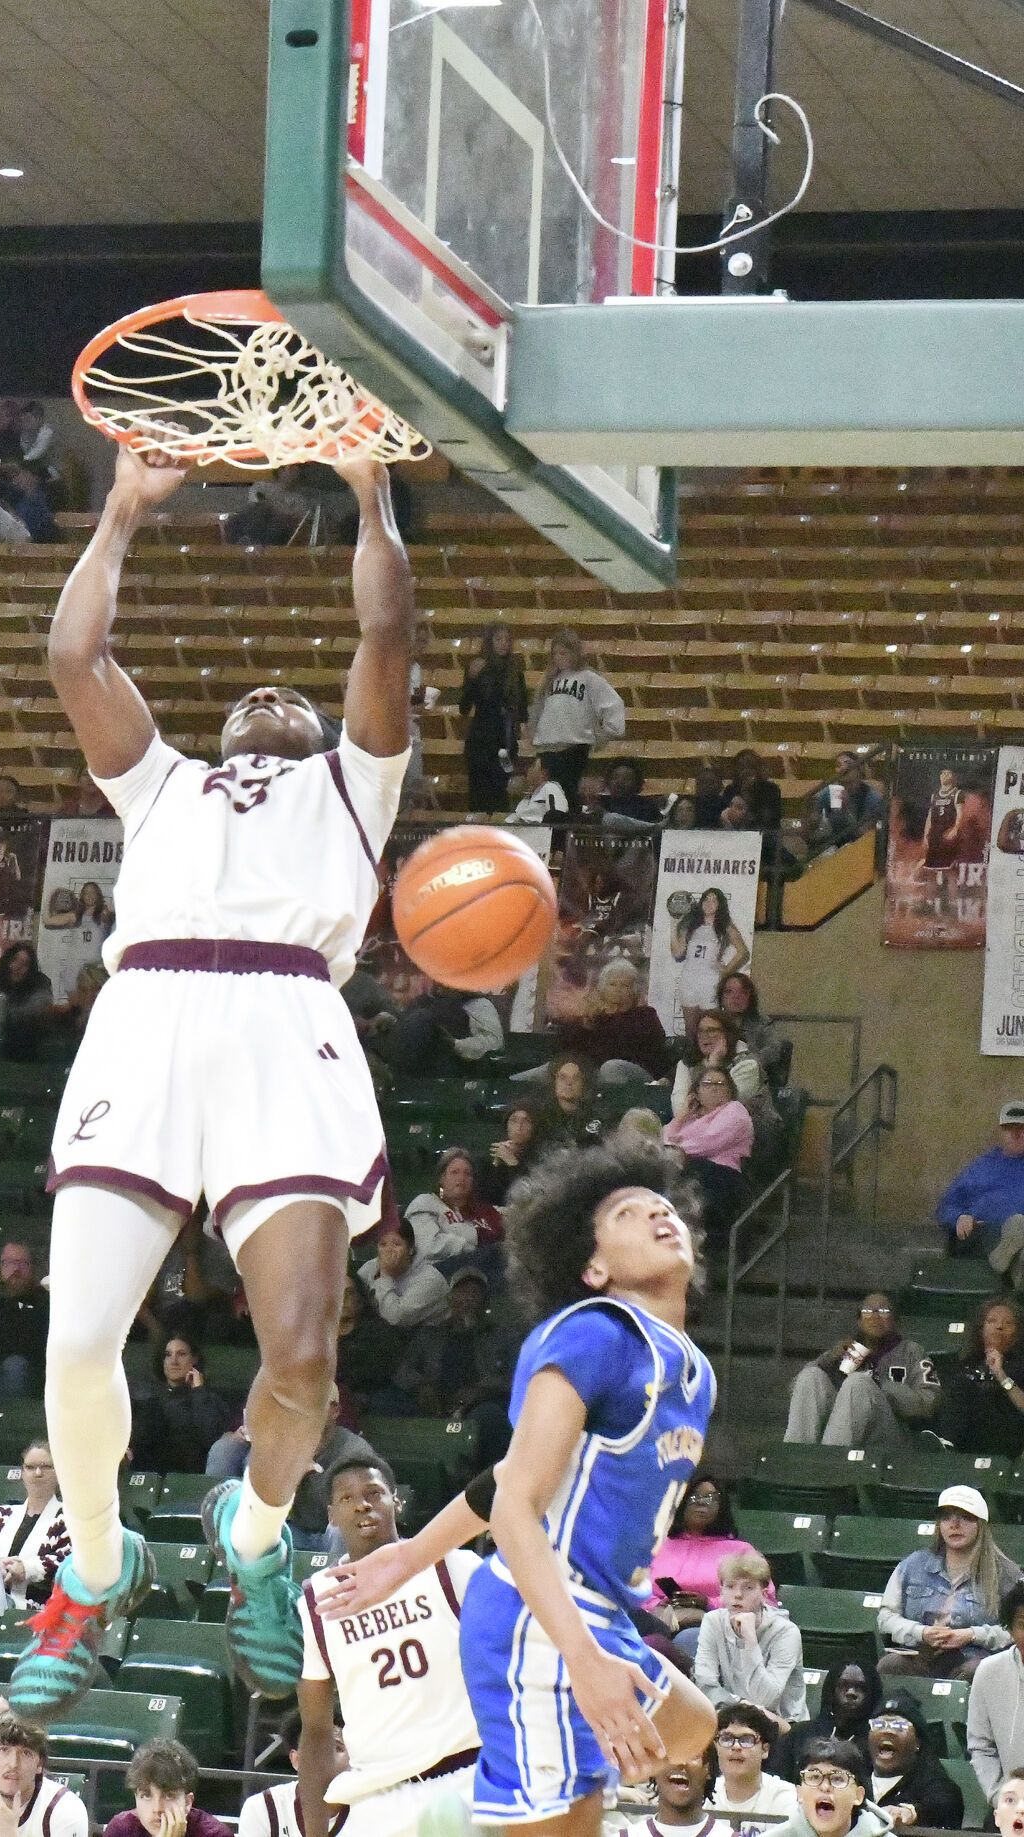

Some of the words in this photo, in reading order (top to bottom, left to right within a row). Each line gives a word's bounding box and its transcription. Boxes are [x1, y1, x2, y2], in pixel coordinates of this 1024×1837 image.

[550, 678, 586, 701] LLAS
[51, 841, 124, 863] RHOADE
[663, 858, 756, 875] MANZANARES
[694, 945, 707, 958] 21
[68, 1100, 111, 1145] L
[9, 1470, 21, 1479] 25
[182, 1548, 195, 1558] 27
[313, 1556, 326, 1566] 28
[339, 1594, 432, 1645] REBELS
[370, 1638, 430, 1689] 20
[151, 1699, 164, 1710] 28
